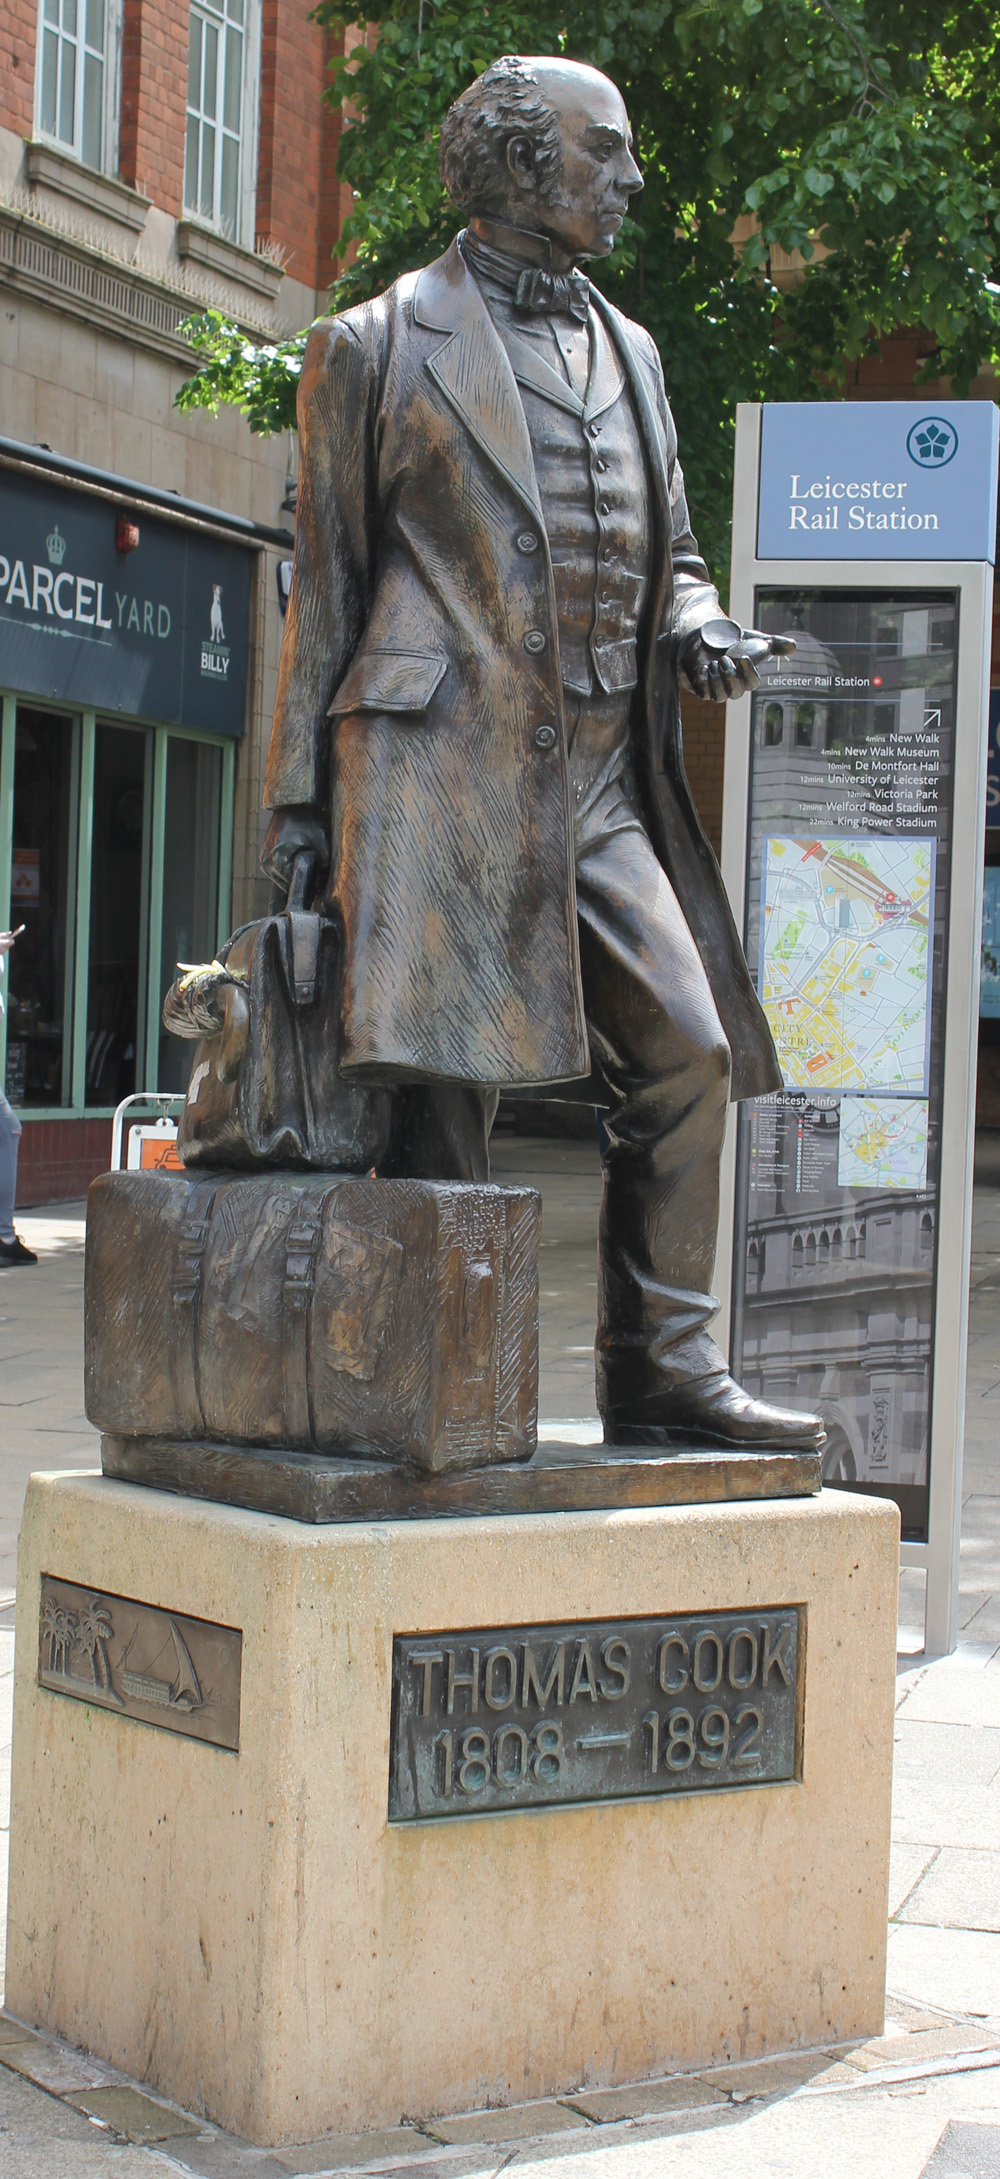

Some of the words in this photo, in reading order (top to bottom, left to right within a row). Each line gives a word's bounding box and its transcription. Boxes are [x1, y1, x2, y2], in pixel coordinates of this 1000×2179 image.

[789, 475, 907, 499] Leicester
[788, 505, 839, 530] Rail
[848, 505, 939, 530] Station
[115, 592, 171, 638] YARD
[201, 652, 230, 674] BILLY
[767, 676, 813, 687] Leicester
[814, 676, 832, 687] Rail
[834, 676, 870, 687] Station
[865, 735, 886, 744] 4mins
[889, 734, 912, 744] New
[915, 733, 940, 744] Walk
[820, 749, 841, 757] 4mins
[844, 747, 867, 757] New
[870, 747, 894, 757] Walk
[897, 747, 940, 758] Museum
[827, 763, 851, 771] 10mins
[855, 761, 869, 771] De
[872, 761, 917, 772] Montfort
[919, 761, 939, 772] Hall
[800, 776, 824, 784] 12mins
[828, 774, 877, 787] University
[879, 775, 891, 786] of
[893, 775, 939, 786] Leicester
[847, 791, 871, 799] 12mins
[874, 788, 913, 800] Victoria
[915, 789, 939, 800] Park
[799, 804, 823, 812] 12mins
[826, 802, 866, 813] Welford
[869, 803, 894, 813] Road
[896, 803, 938, 814] Stadium
[809, 819, 834, 827] 22mins
[837, 816, 860, 829] King
[861, 817, 893, 828] Power
[895, 817, 937, 828] Stadium
[754, 1094, 837, 1107] visitleicester.info
[408, 1635, 632, 1717] THOMAS
[656, 1622, 793, 1695] COOK
[436, 1719, 566, 1796] 1808
[643, 1702, 766, 1774] 1892
